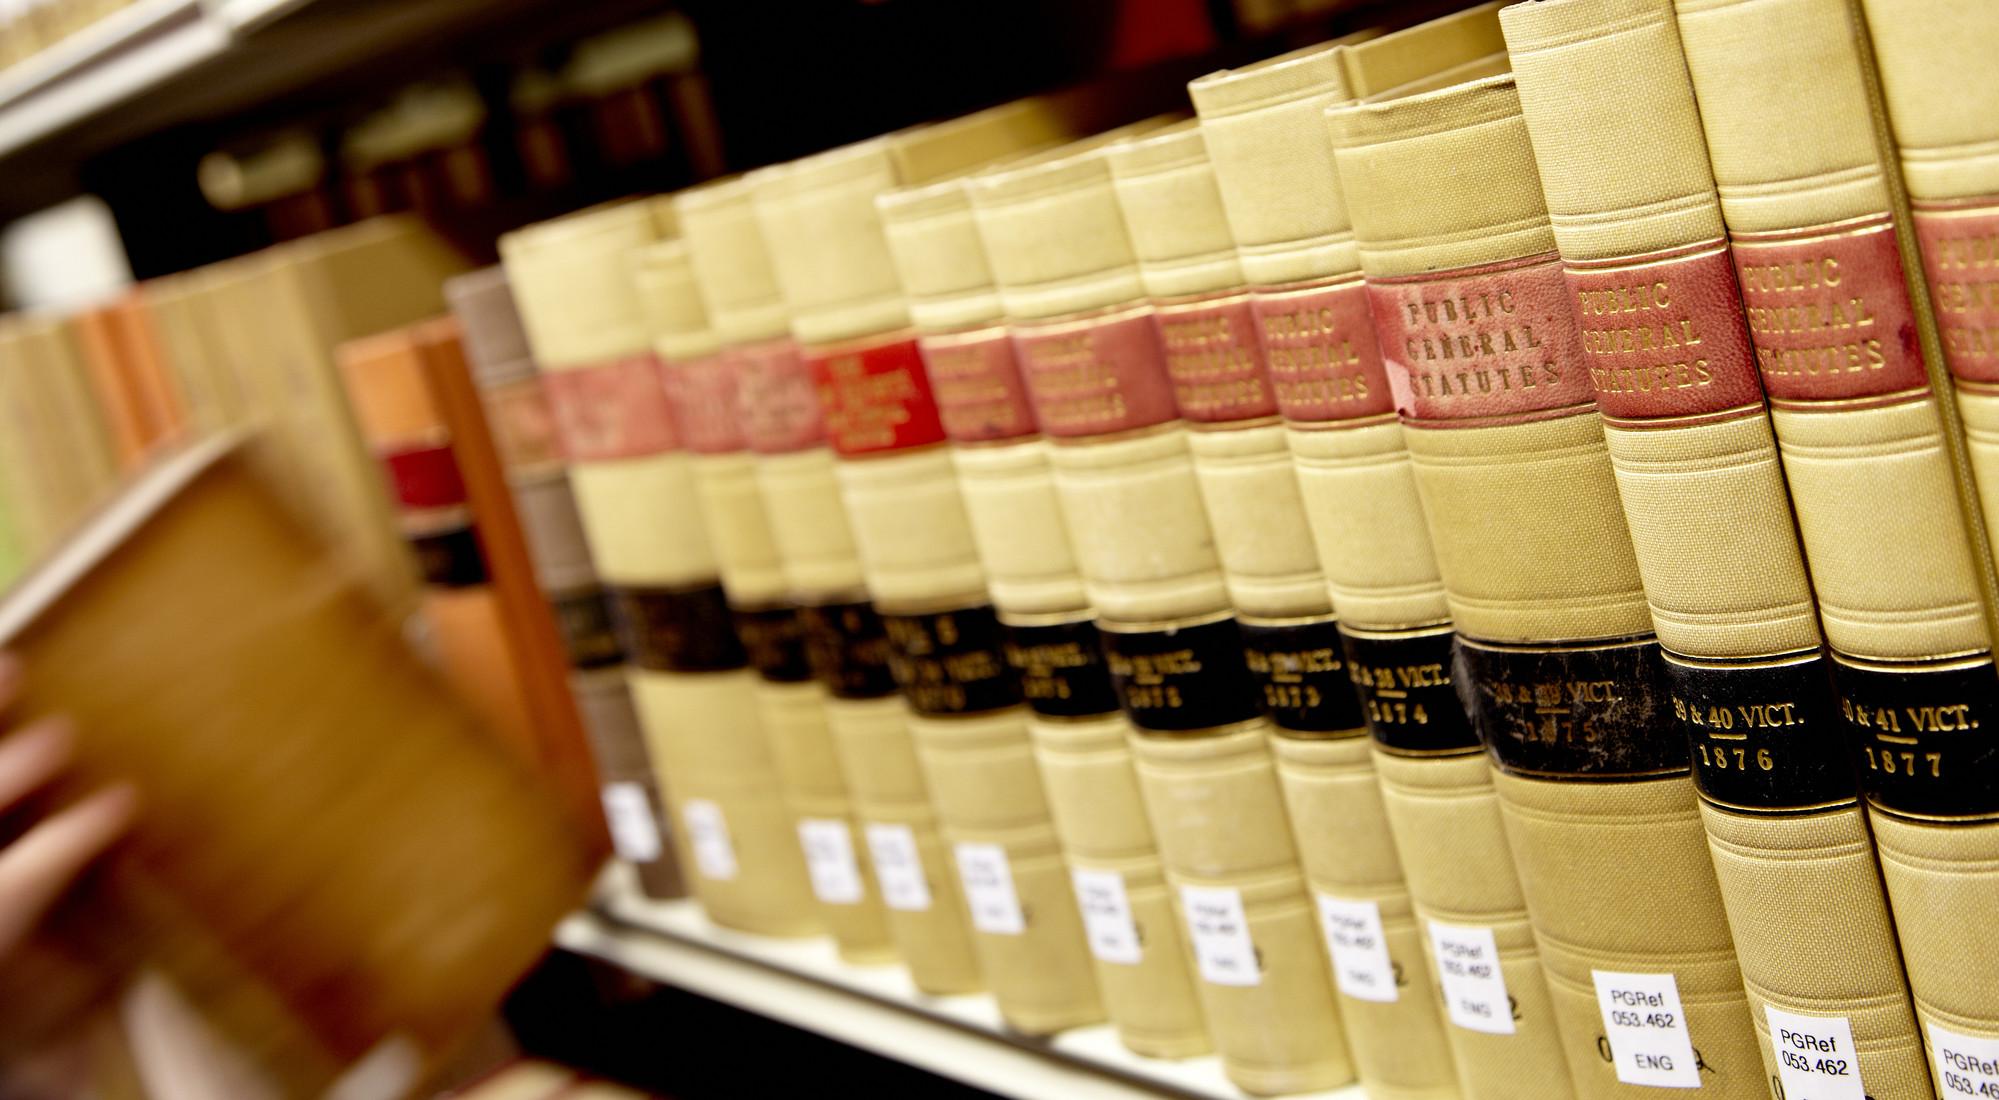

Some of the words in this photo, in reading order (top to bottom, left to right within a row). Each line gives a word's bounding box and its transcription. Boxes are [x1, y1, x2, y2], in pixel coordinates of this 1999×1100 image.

[1744, 258, 1841, 292] PUBLIC
[1407, 290, 1515, 326] PUBLIC
[1578, 283, 1670, 315] PUBLIC
[1749, 298, 1873, 333] GENERAL
[1406, 325, 1543, 362] GENERAL
[1583, 320, 1701, 354] GENERAL
[1408, 361, 1560, 400] STATUTES
[1591, 360, 1713, 393] STATUTES
[1566, 680, 1623, 703] VICT.
[1689, 703, 1704, 726] &
[1708, 705, 1733, 729] 40
[1738, 702, 1805, 728] VICT.
[1856, 703, 1871, 728] &
[1876, 707, 1902, 732] 41
[1906, 704, 1980, 732] VICT.
[1699, 743, 1774, 771] 1876
[1865, 746, 1941, 778] 1877
[1610, 989, 1665, 1007] PGRef
[1611, 1010, 1677, 1029] 053.462
[1780, 1028, 1836, 1052] PGRef
[1634, 1053, 1675, 1071] ENG
[1782, 1050, 1849, 1076] 053.462
[1945, 1071, 1999, 1100] 053.46
